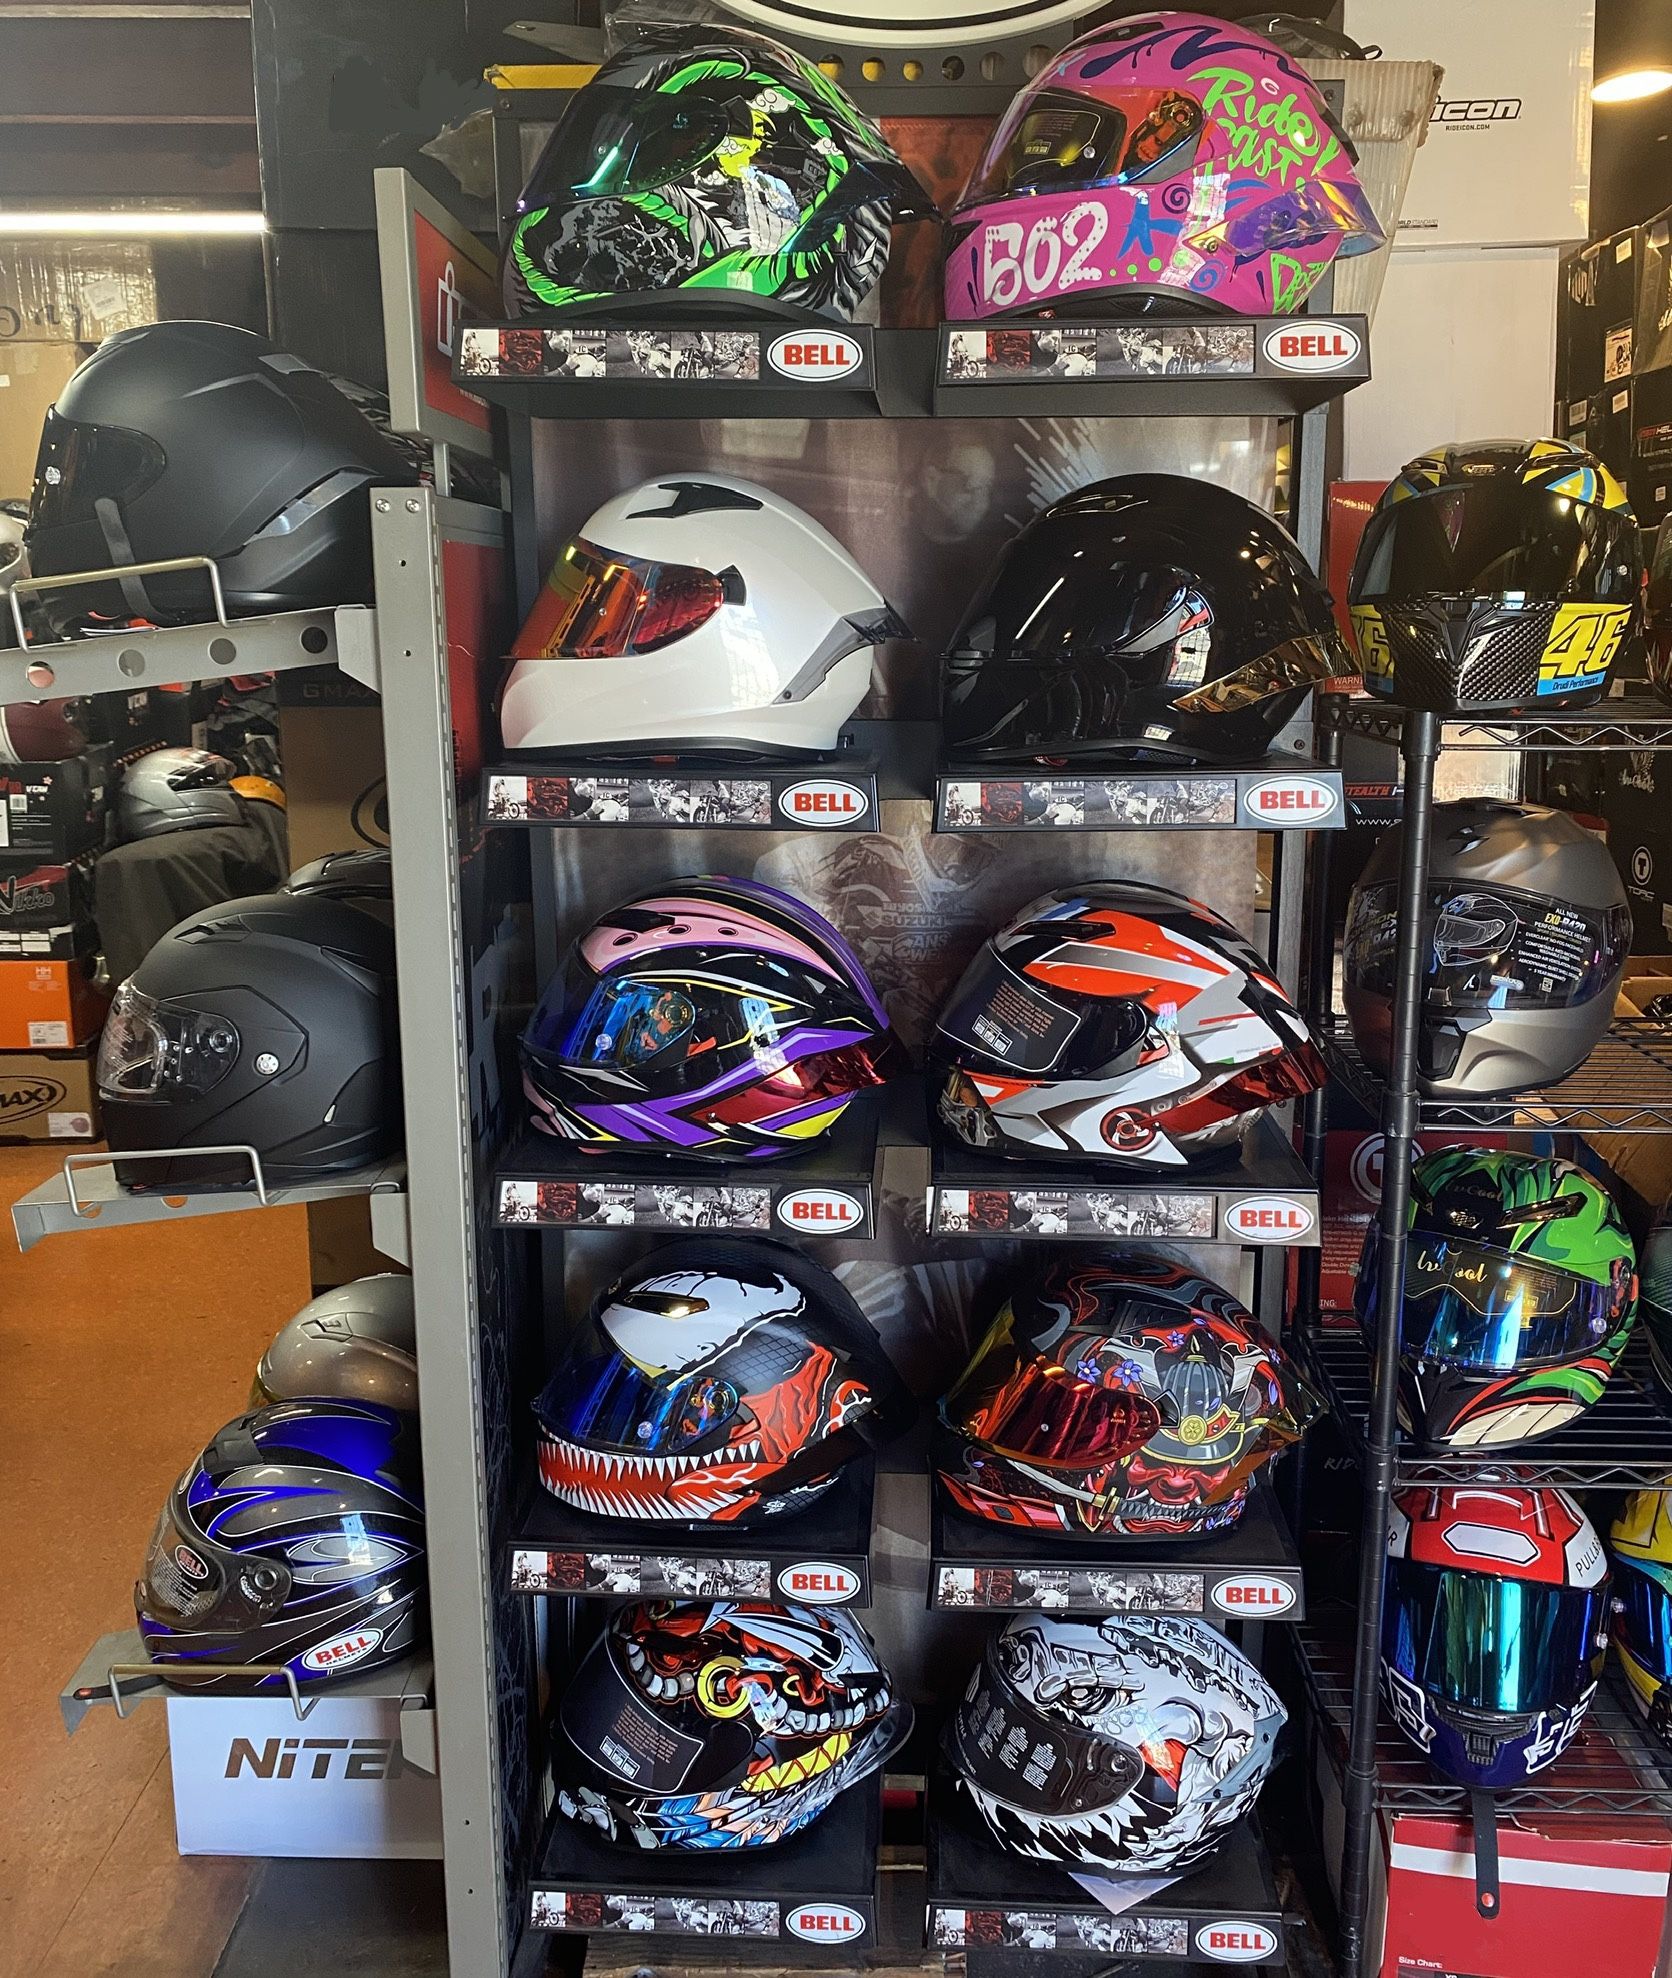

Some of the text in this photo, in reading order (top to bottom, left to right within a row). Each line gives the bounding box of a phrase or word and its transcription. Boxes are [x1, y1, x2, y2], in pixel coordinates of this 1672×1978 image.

[783, 343, 850, 366] BELL
[1279, 335, 1349, 358] BELL
[1540, 607, 1632, 677] 46
[793, 792, 856, 813] BELL
[1259, 790, 1326, 810] BELL
[880, 914, 946, 927] SUZUKI
[1555, 908, 1579, 920] ALL NEW
[1534, 921, 1574, 938] PERFORMANCE
[1574, 932, 1592, 943] HELMET
[792, 1201, 852, 1221] BELL
[1239, 1209, 1303, 1229] BELL
[1324, 1457, 1360, 1471] RID
[791, 1573, 849, 1592] BELL
[1225, 1586, 1285, 1604] BELL
[315, 1636, 372, 1664] BELL
[800, 1914, 855, 1932] BELL
[1209, 1931, 1267, 1950] BELL
[1398, 1956, 1443, 1968] Size Chart:
